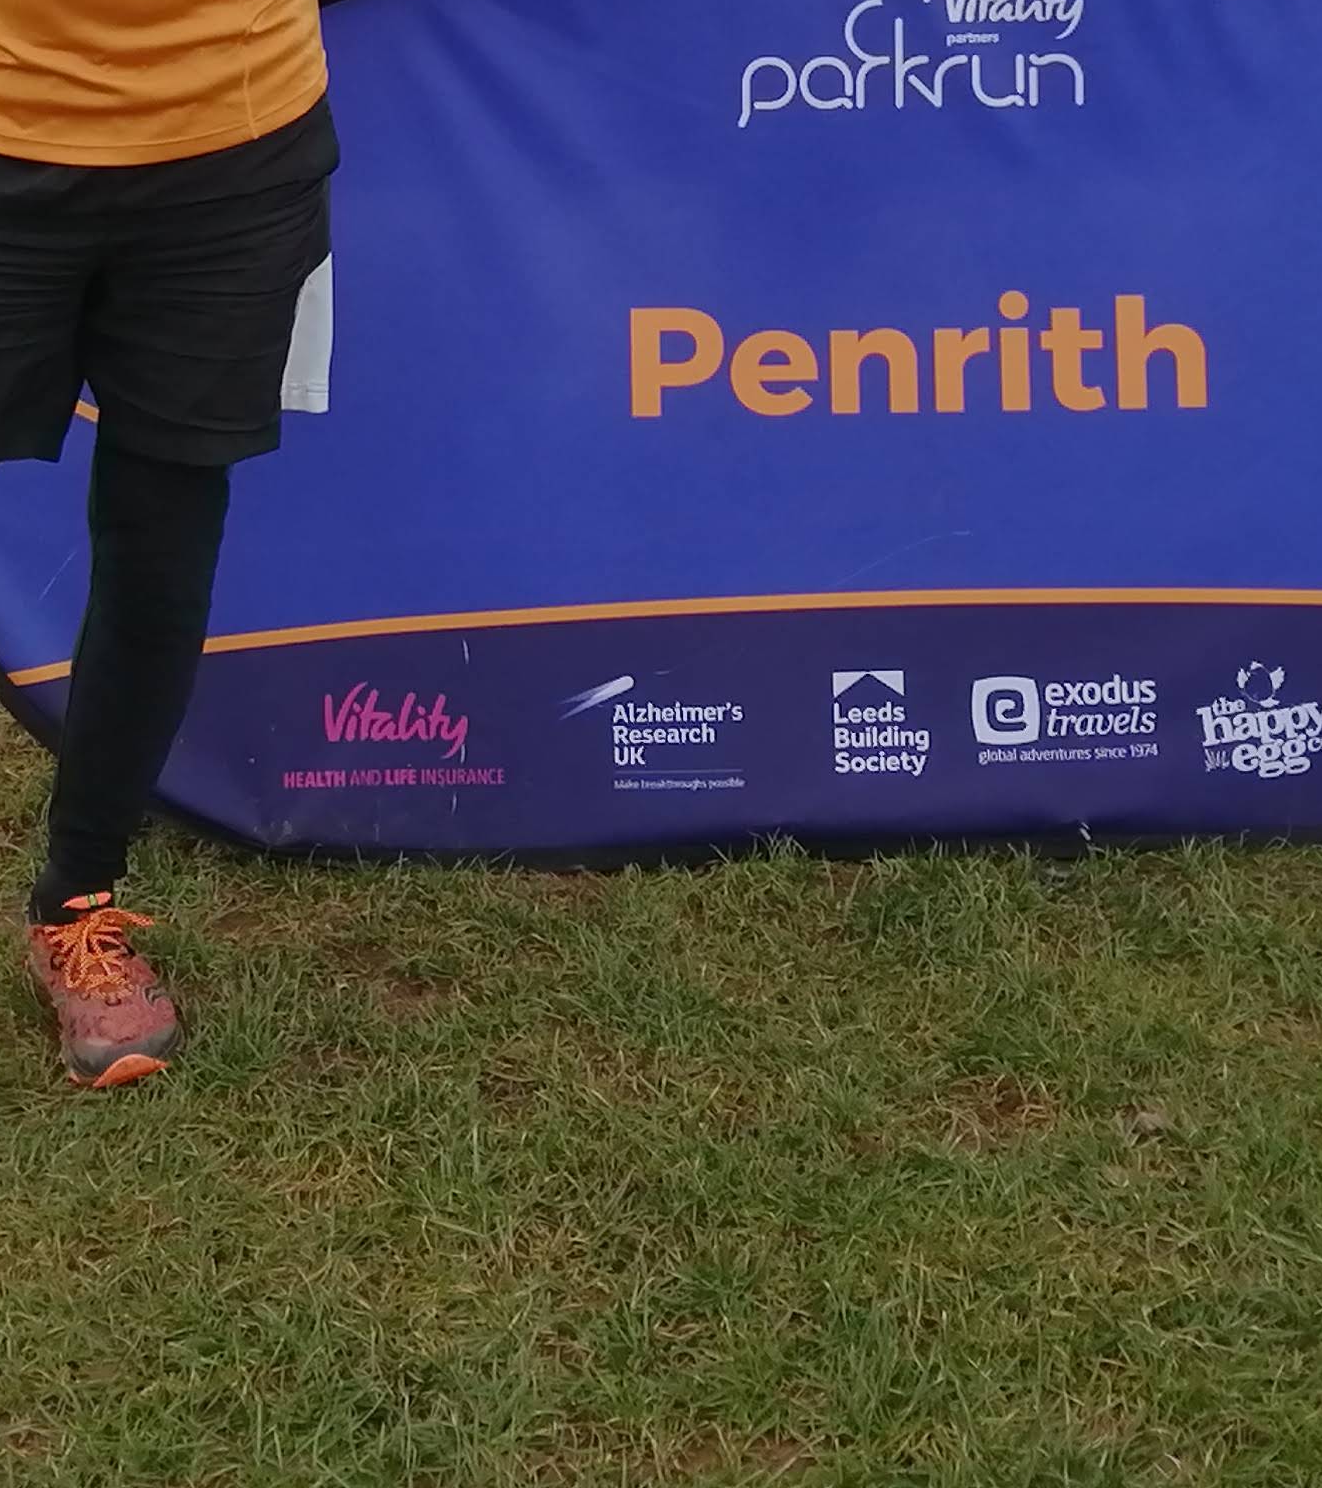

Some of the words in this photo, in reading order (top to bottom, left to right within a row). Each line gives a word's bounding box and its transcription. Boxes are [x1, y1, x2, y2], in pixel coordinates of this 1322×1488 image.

[946, 31, 1000, 47] partners
[738, 17, 1085, 129] parkrun
[630, 290, 1208, 417] Penrith
[1045, 674, 1157, 706] exodus
[613, 701, 744, 724] Alzheimer's
[833, 701, 906, 724] Leeds
[1212, 697, 1246, 716] the
[324, 681, 469, 759] Vitality
[1046, 706, 1158, 738] travels
[613, 723, 716, 745] Research
[834, 725, 930, 752] Building
[614, 745, 646, 766] UK
[835, 751, 927, 777] Society
[978, 748, 1017, 766] global
[1019, 747, 1092, 762] adventures
[1094, 745, 1127, 759] since
[1130, 743, 1159, 758] 1974
[1231, 734, 1311, 778] egg
[283, 770, 346, 789] HEALTH
[350, 769, 381, 787] AND
[385, 768, 417, 786] LIFE
[420, 767, 506, 785] INSURANCE
